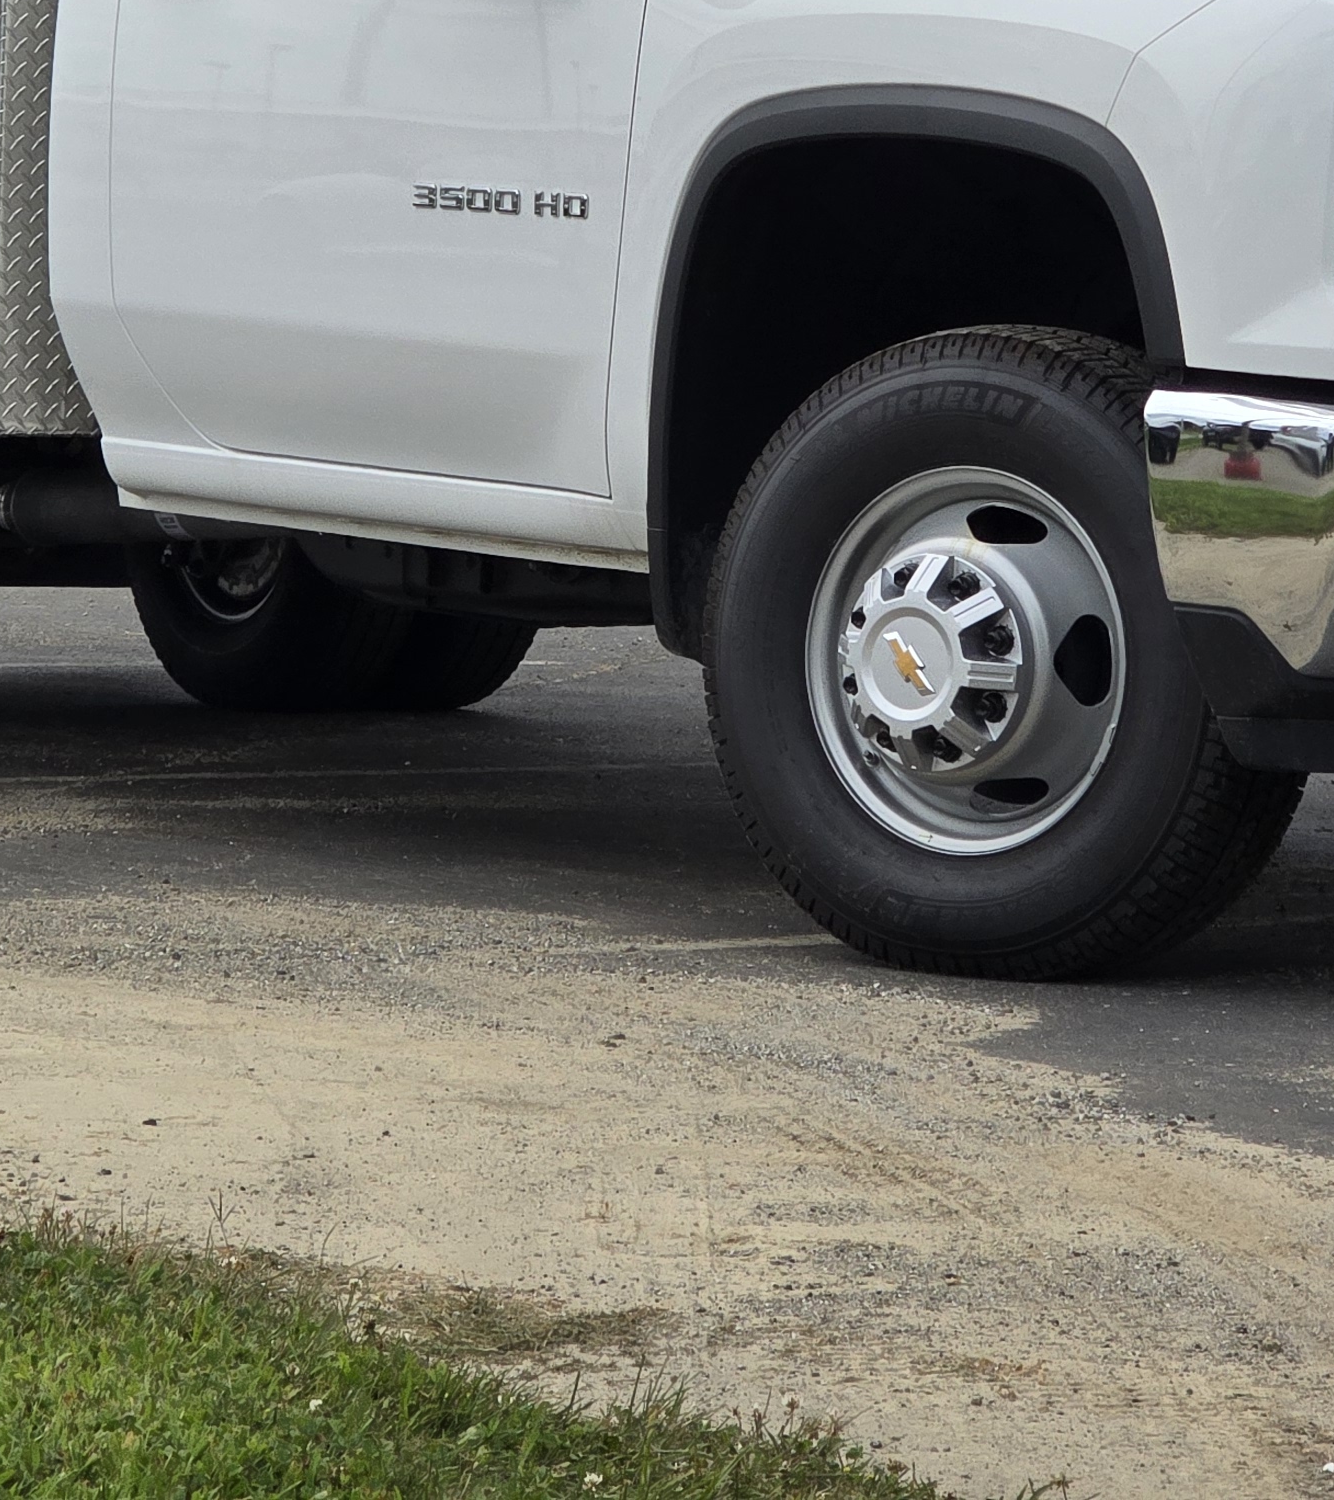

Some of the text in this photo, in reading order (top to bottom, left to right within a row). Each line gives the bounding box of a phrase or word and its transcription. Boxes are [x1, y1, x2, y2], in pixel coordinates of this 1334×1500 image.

[412, 182, 590, 220] 3500 HD
[856, 385, 1024, 429] MICHELIN
